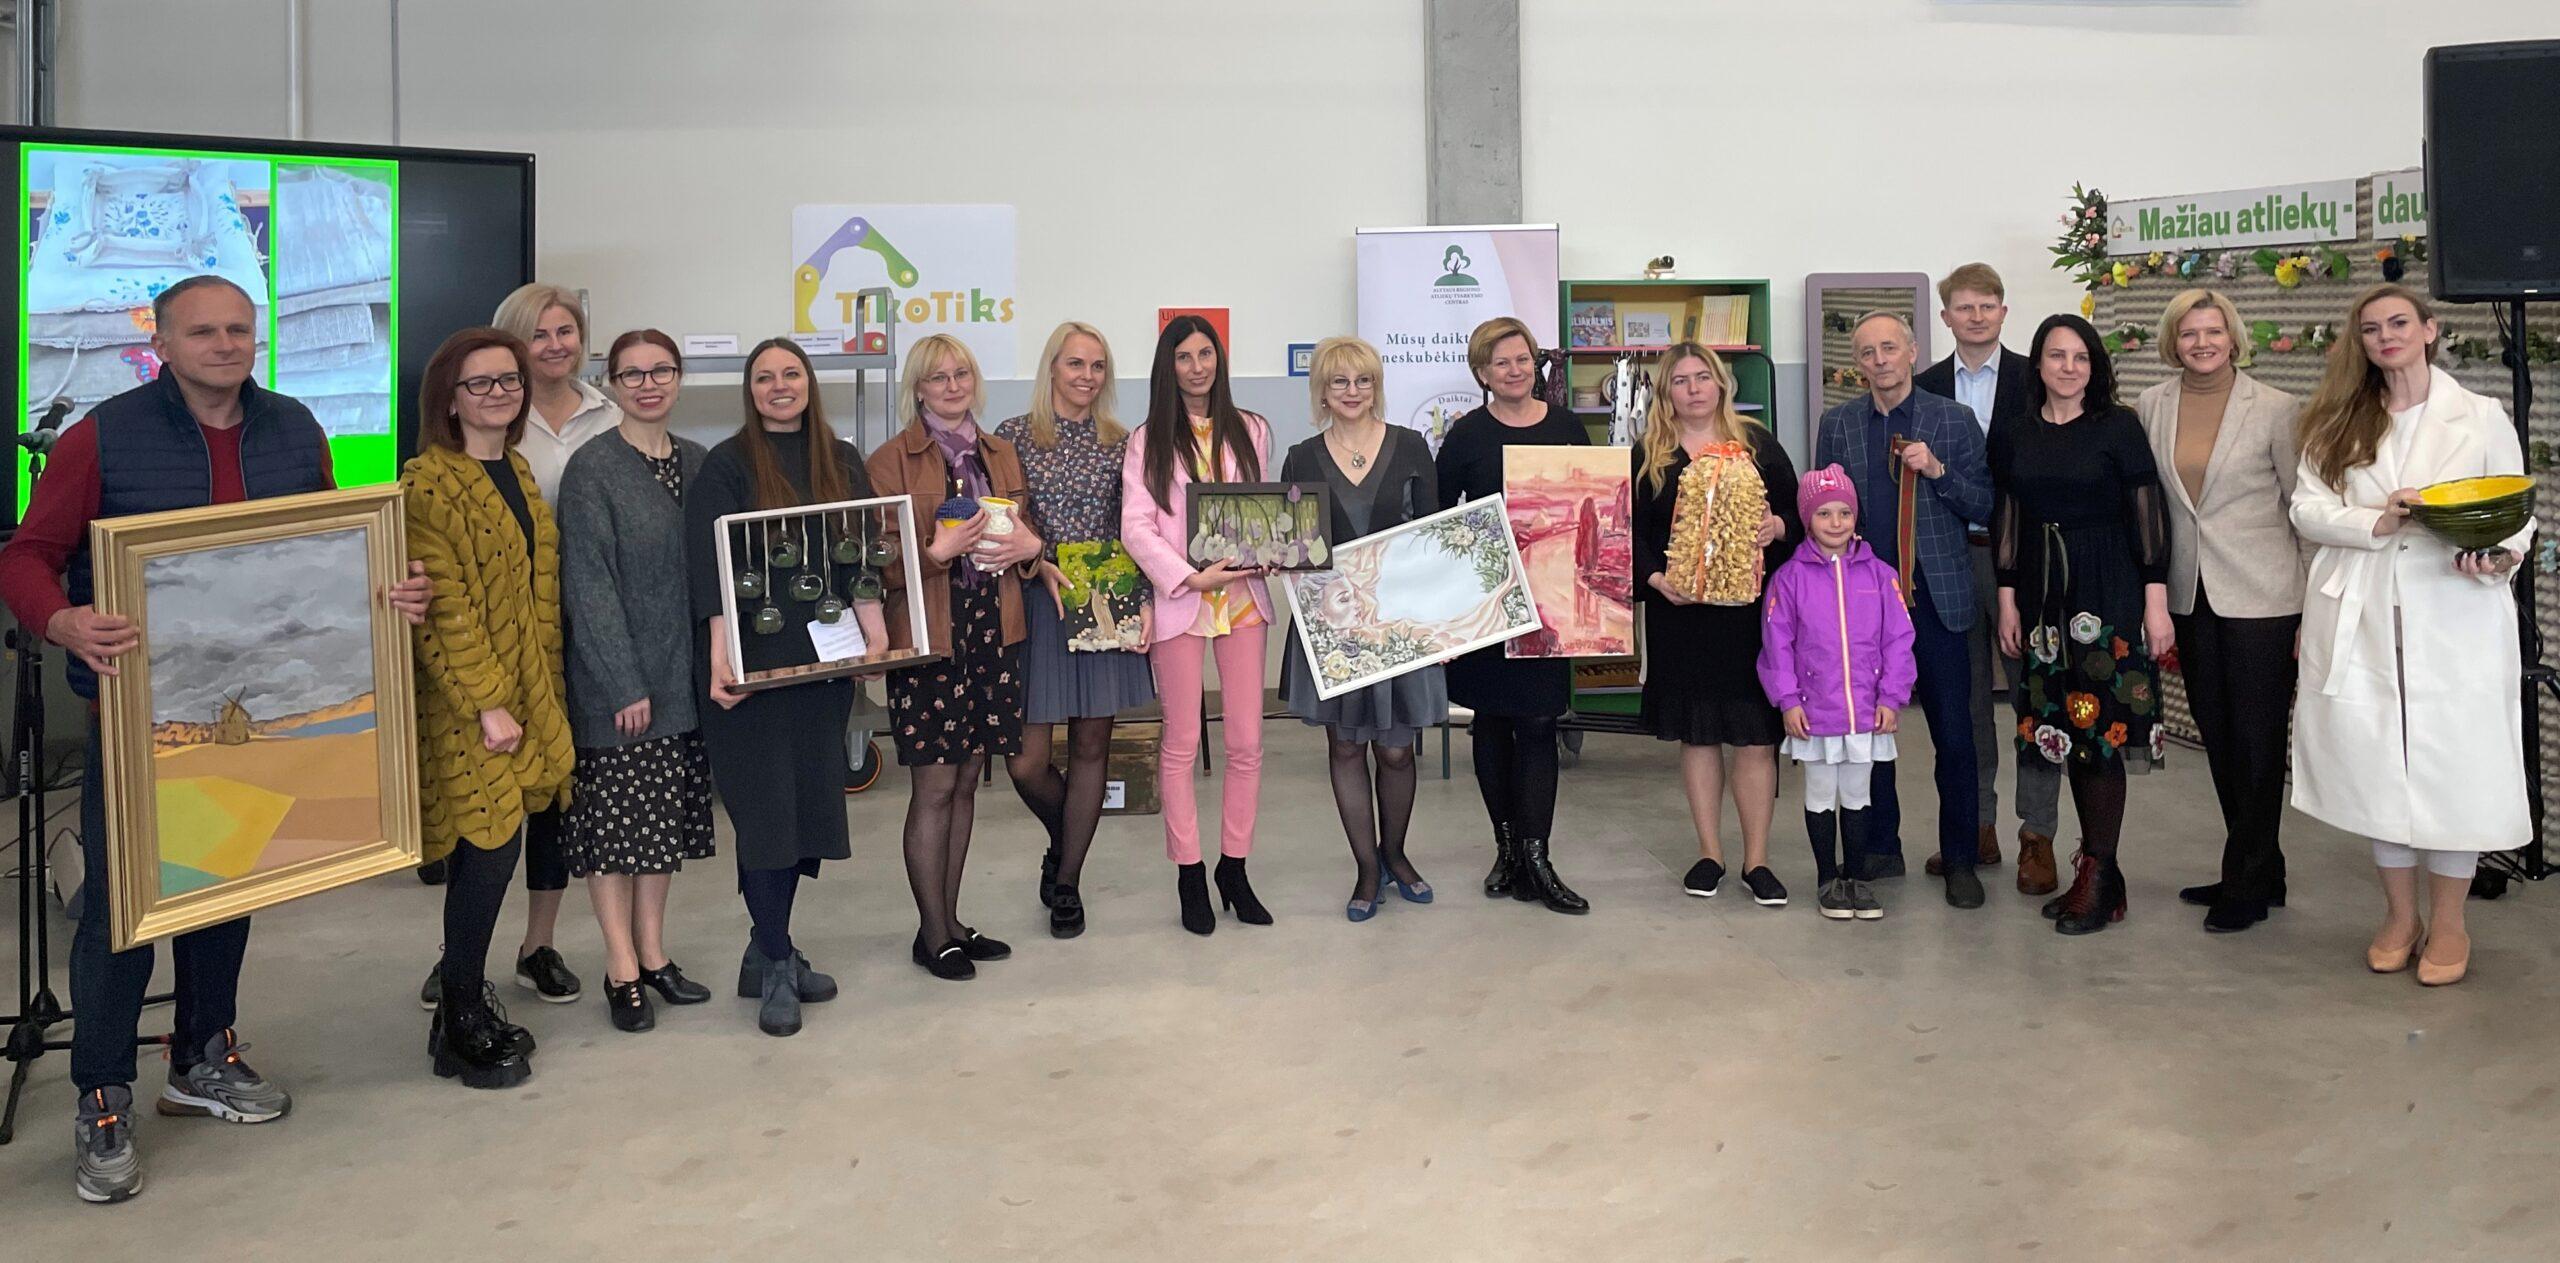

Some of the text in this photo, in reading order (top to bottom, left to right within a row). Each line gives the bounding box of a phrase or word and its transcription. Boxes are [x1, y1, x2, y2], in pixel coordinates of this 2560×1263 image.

[2138, 203, 2231, 241] Mažiau
[2237, 191, 2338, 237] atliekų
[2378, 181, 2428, 225] dau
[1386, 332, 1469, 347] Mūsų daikt
[1382, 351, 1469, 363] neskubėkim
[1438, 394, 1472, 404] Daiktai
